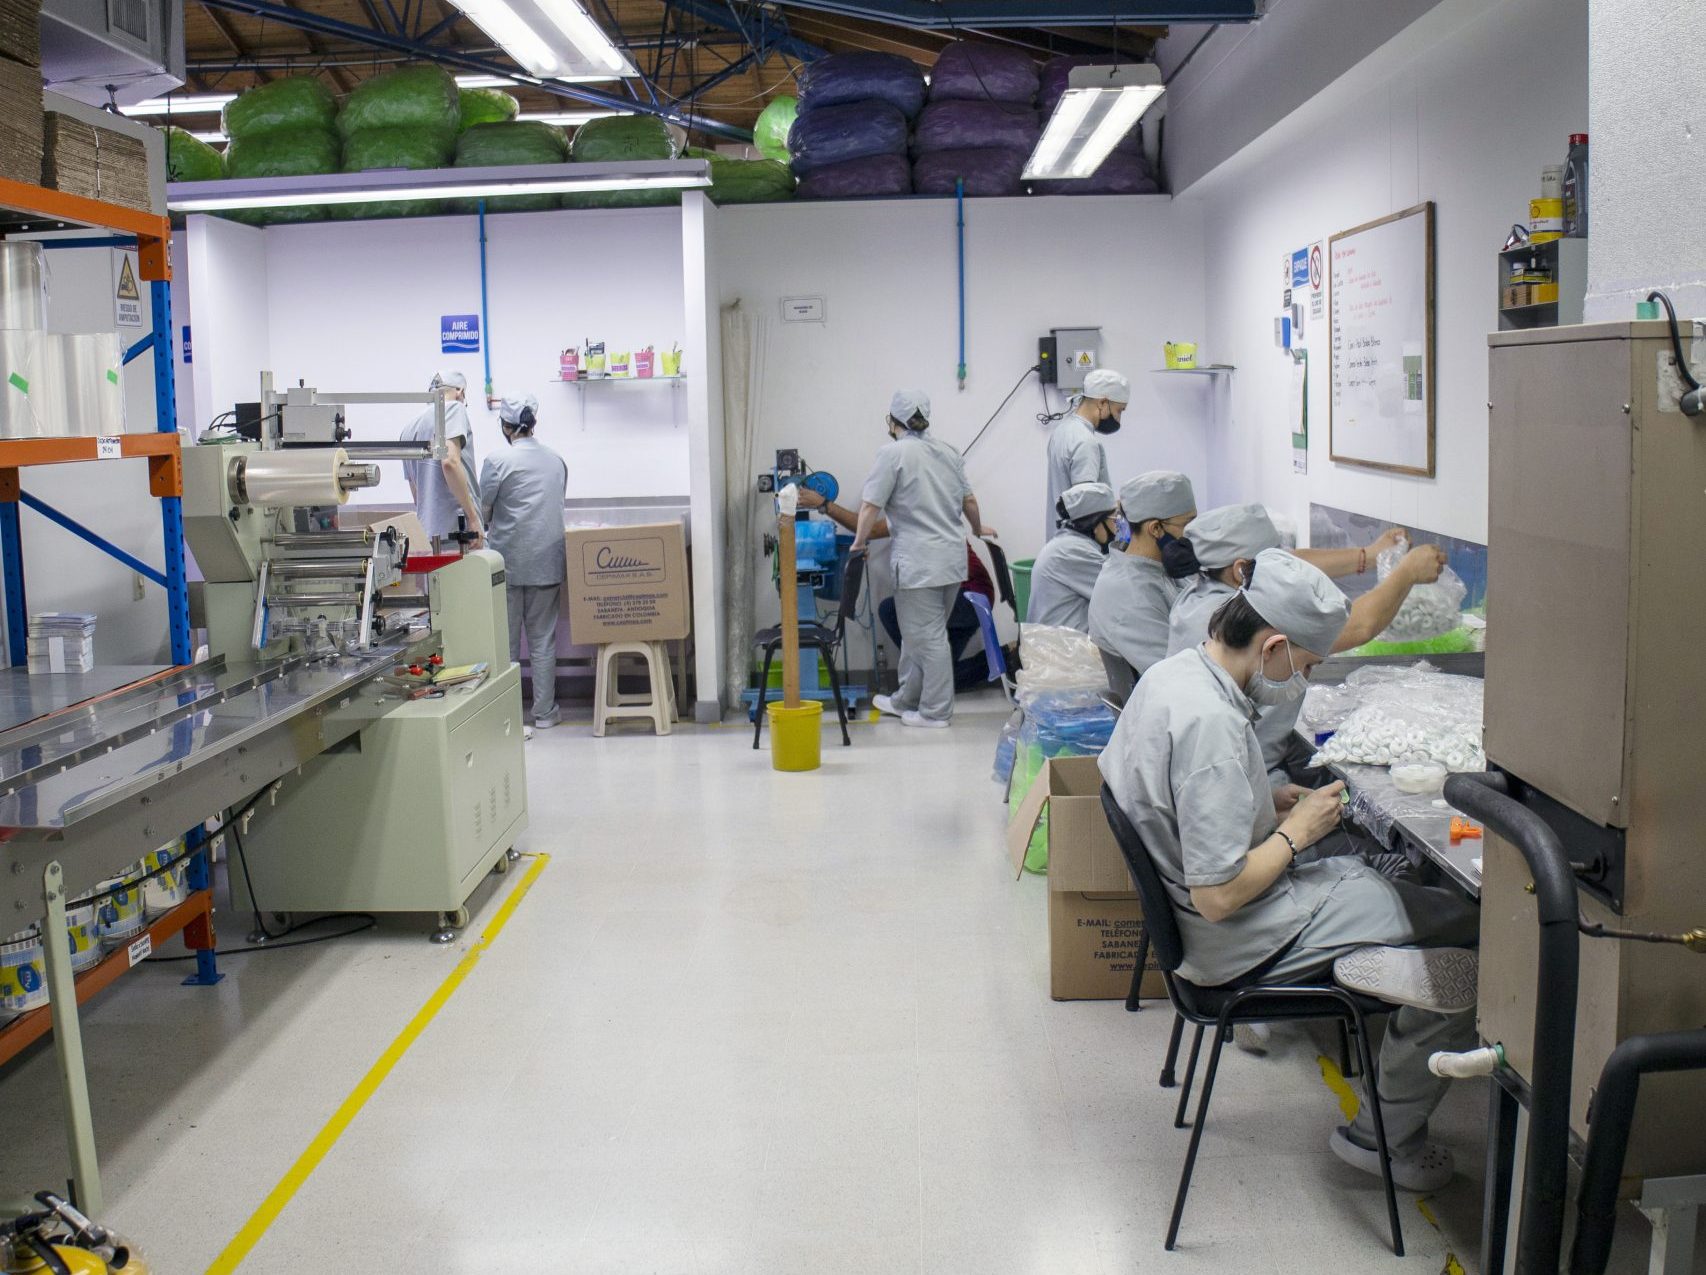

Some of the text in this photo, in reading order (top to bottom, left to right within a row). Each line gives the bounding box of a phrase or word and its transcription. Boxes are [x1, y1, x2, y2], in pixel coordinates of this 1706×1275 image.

[452, 321, 468, 330] AIRE
[442, 331, 479, 341] COMPRIMIDO
[1077, 919, 1144, 929] E-MAIL: comer
